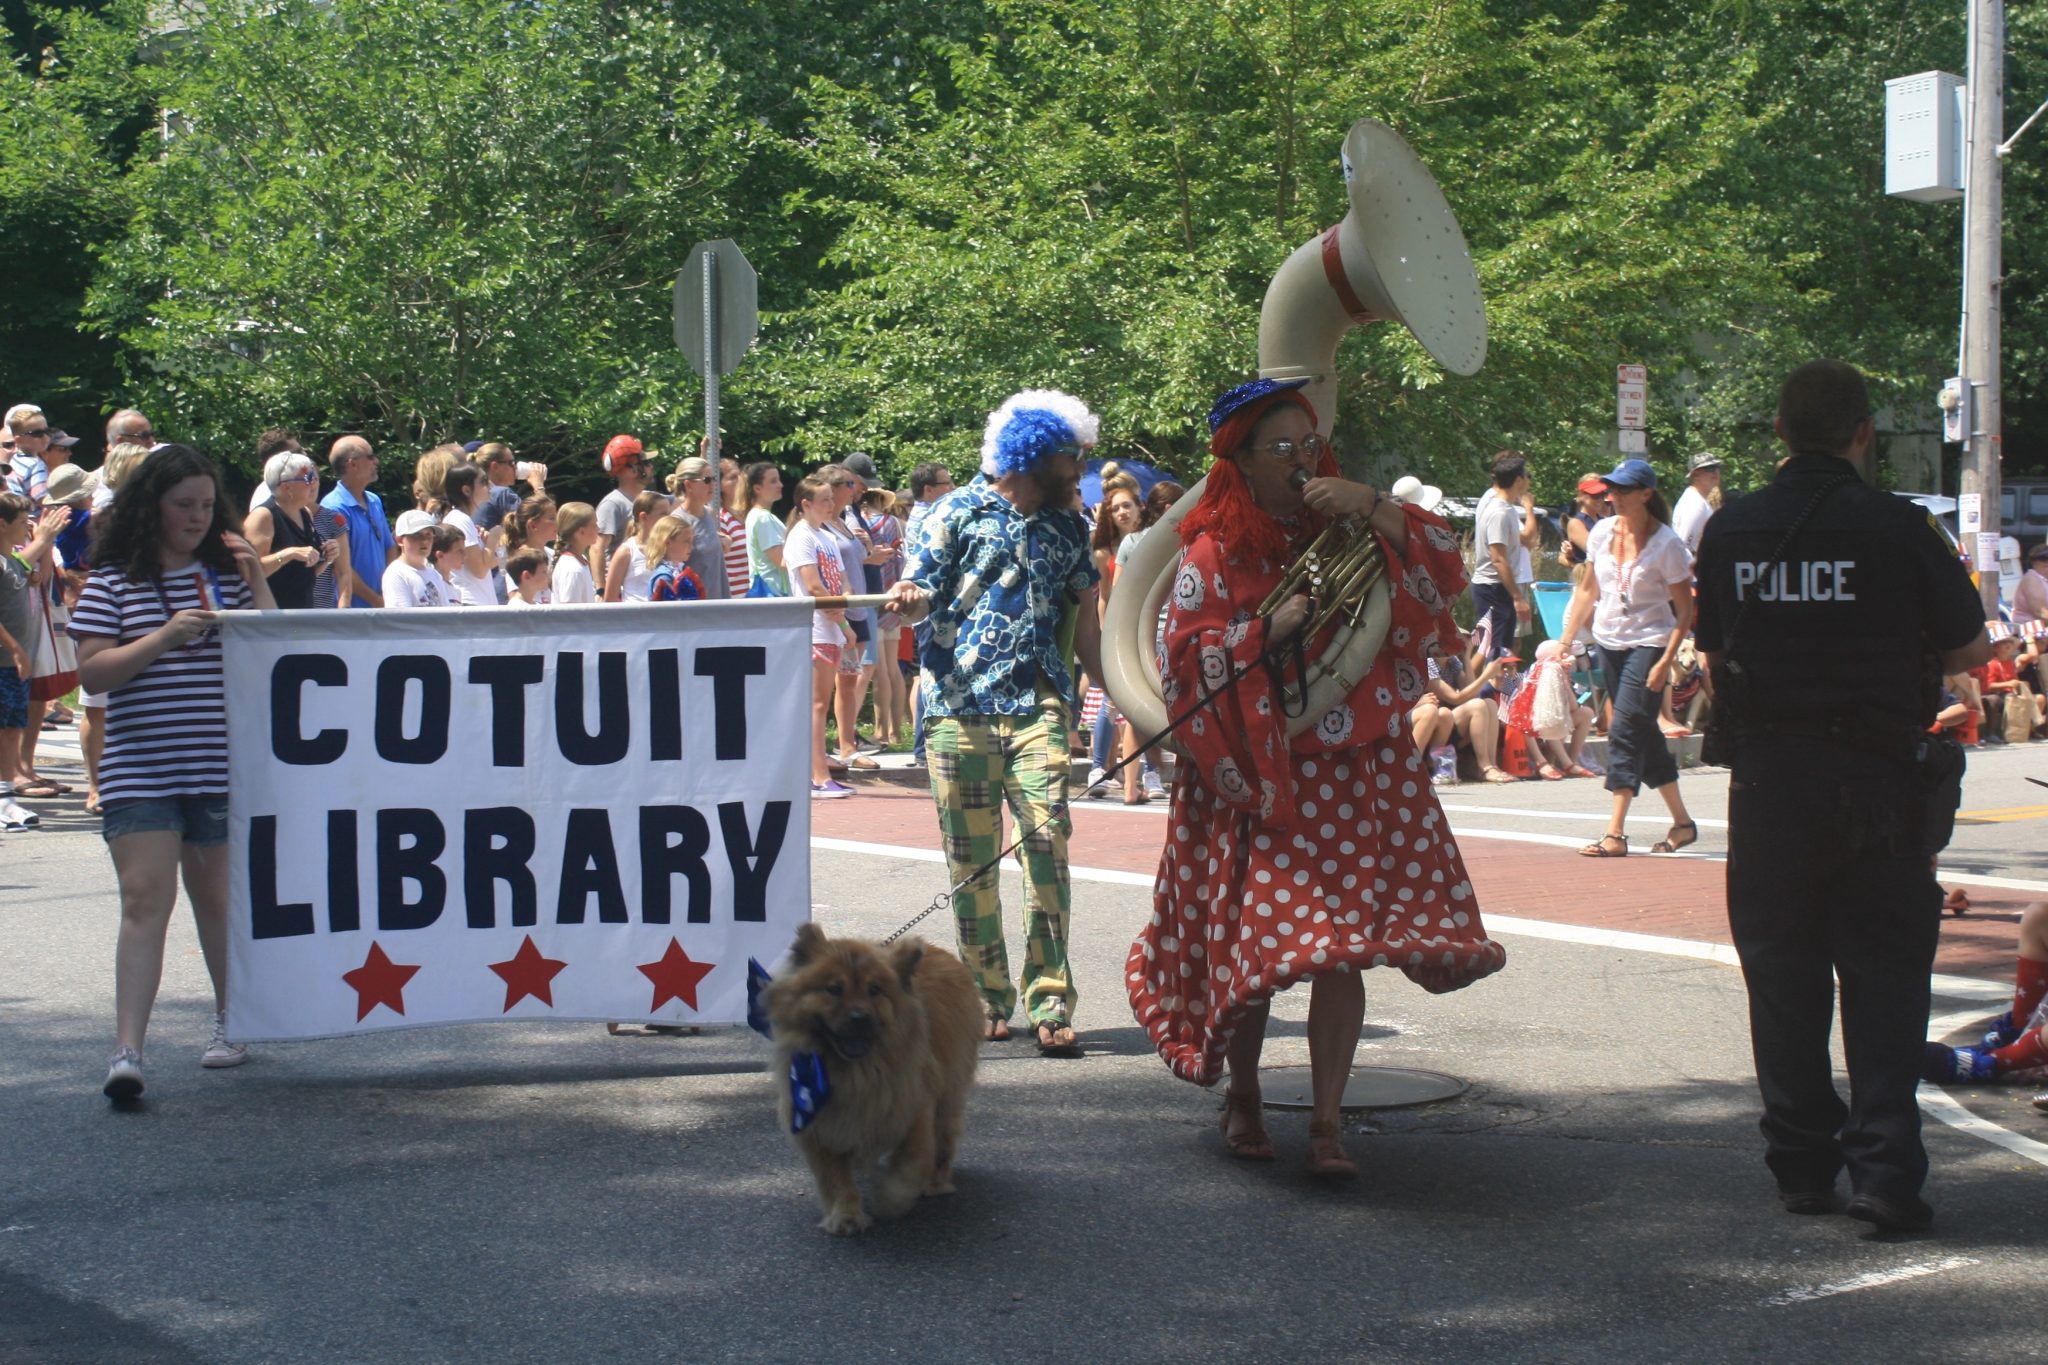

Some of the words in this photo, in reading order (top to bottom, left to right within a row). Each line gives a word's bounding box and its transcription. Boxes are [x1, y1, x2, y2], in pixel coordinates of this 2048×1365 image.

[1735, 560, 1856, 601] POLICE
[271, 646, 766, 767] COTUIT
[248, 801, 792, 939] LIBRARY
[1955, 1050, 1973, 1075] NIKE
